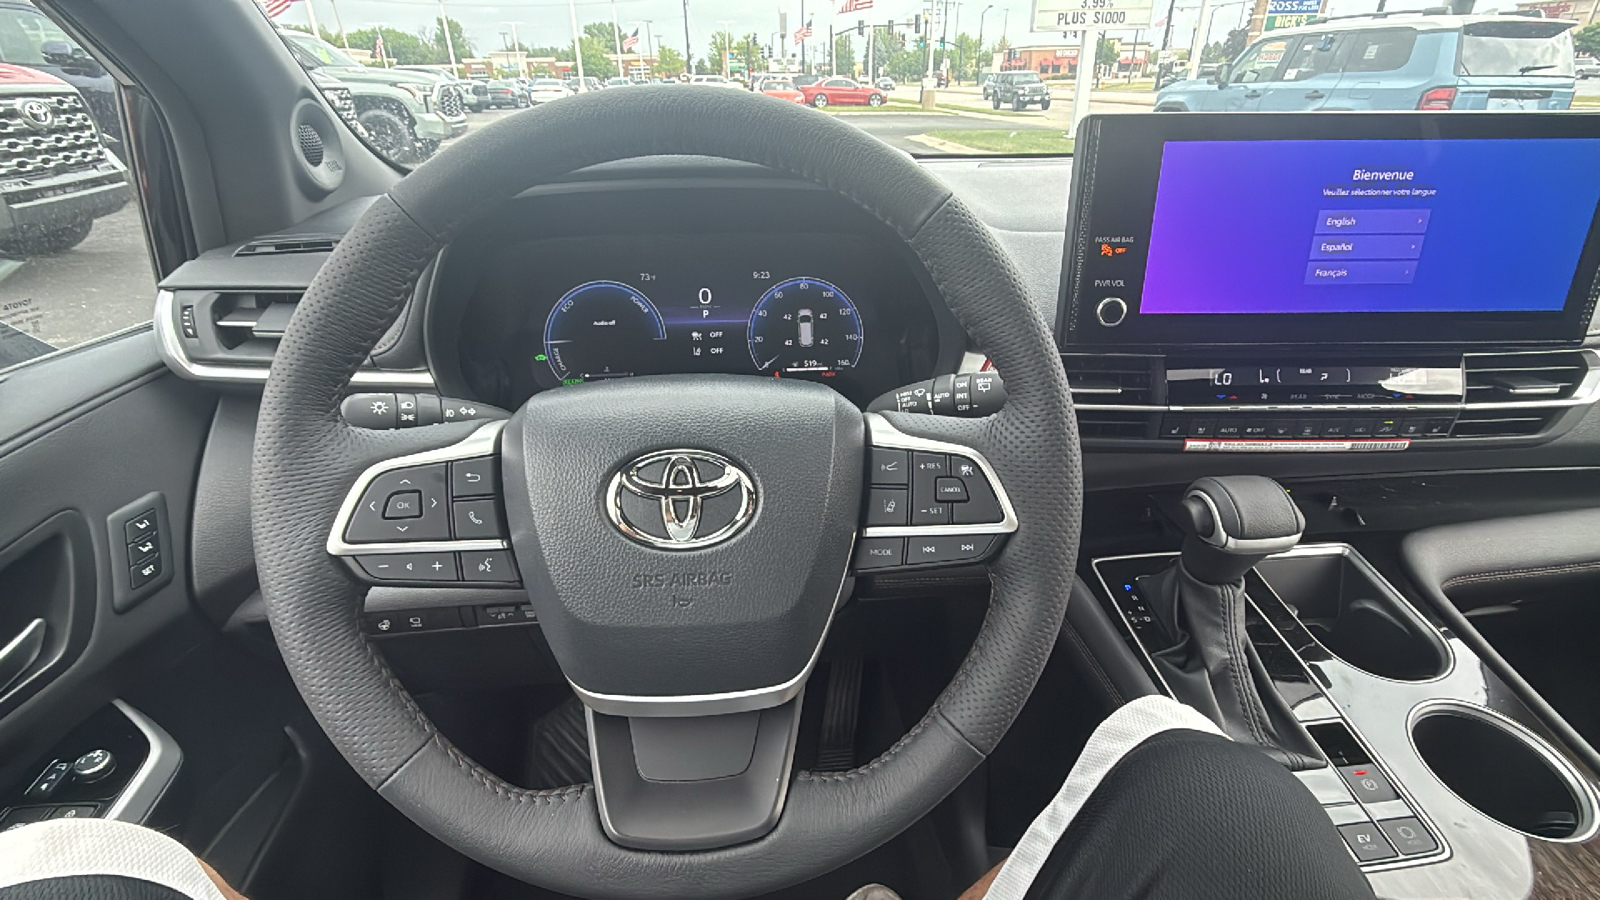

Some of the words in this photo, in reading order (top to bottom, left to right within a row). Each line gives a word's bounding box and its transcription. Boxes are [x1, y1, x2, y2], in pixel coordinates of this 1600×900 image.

[1057, 12, 1086, 25] PLUS
[1352, 169, 1414, 181] Bienvenue
[1411, 188, 1437, 197] langue
[1326, 217, 1356, 227] English
[1321, 243, 1353, 252] Español
[752, 271, 770, 279] 9:23
[1315, 268, 1348, 278] Français
[799, 282, 809, 290] 80
[1094, 279, 1111, 287] PWR
[1111, 279, 1125, 287] VOL
[698, 287, 712, 304] 0
[822, 290, 835, 298] 100
[561, 299, 574, 313] ECO
[630, 295, 649, 313] POWER
[702, 309, 709, 319] P
[839, 308, 851, 316] 120
[804, 359, 817, 367] 519
[396, 501, 410, 509] OK
[869, 548, 893, 556] MODE
[631, 574, 667, 589] SRS
[668, 572, 733, 588] AIRBAG
[1357, 834, 1371, 844] EV
